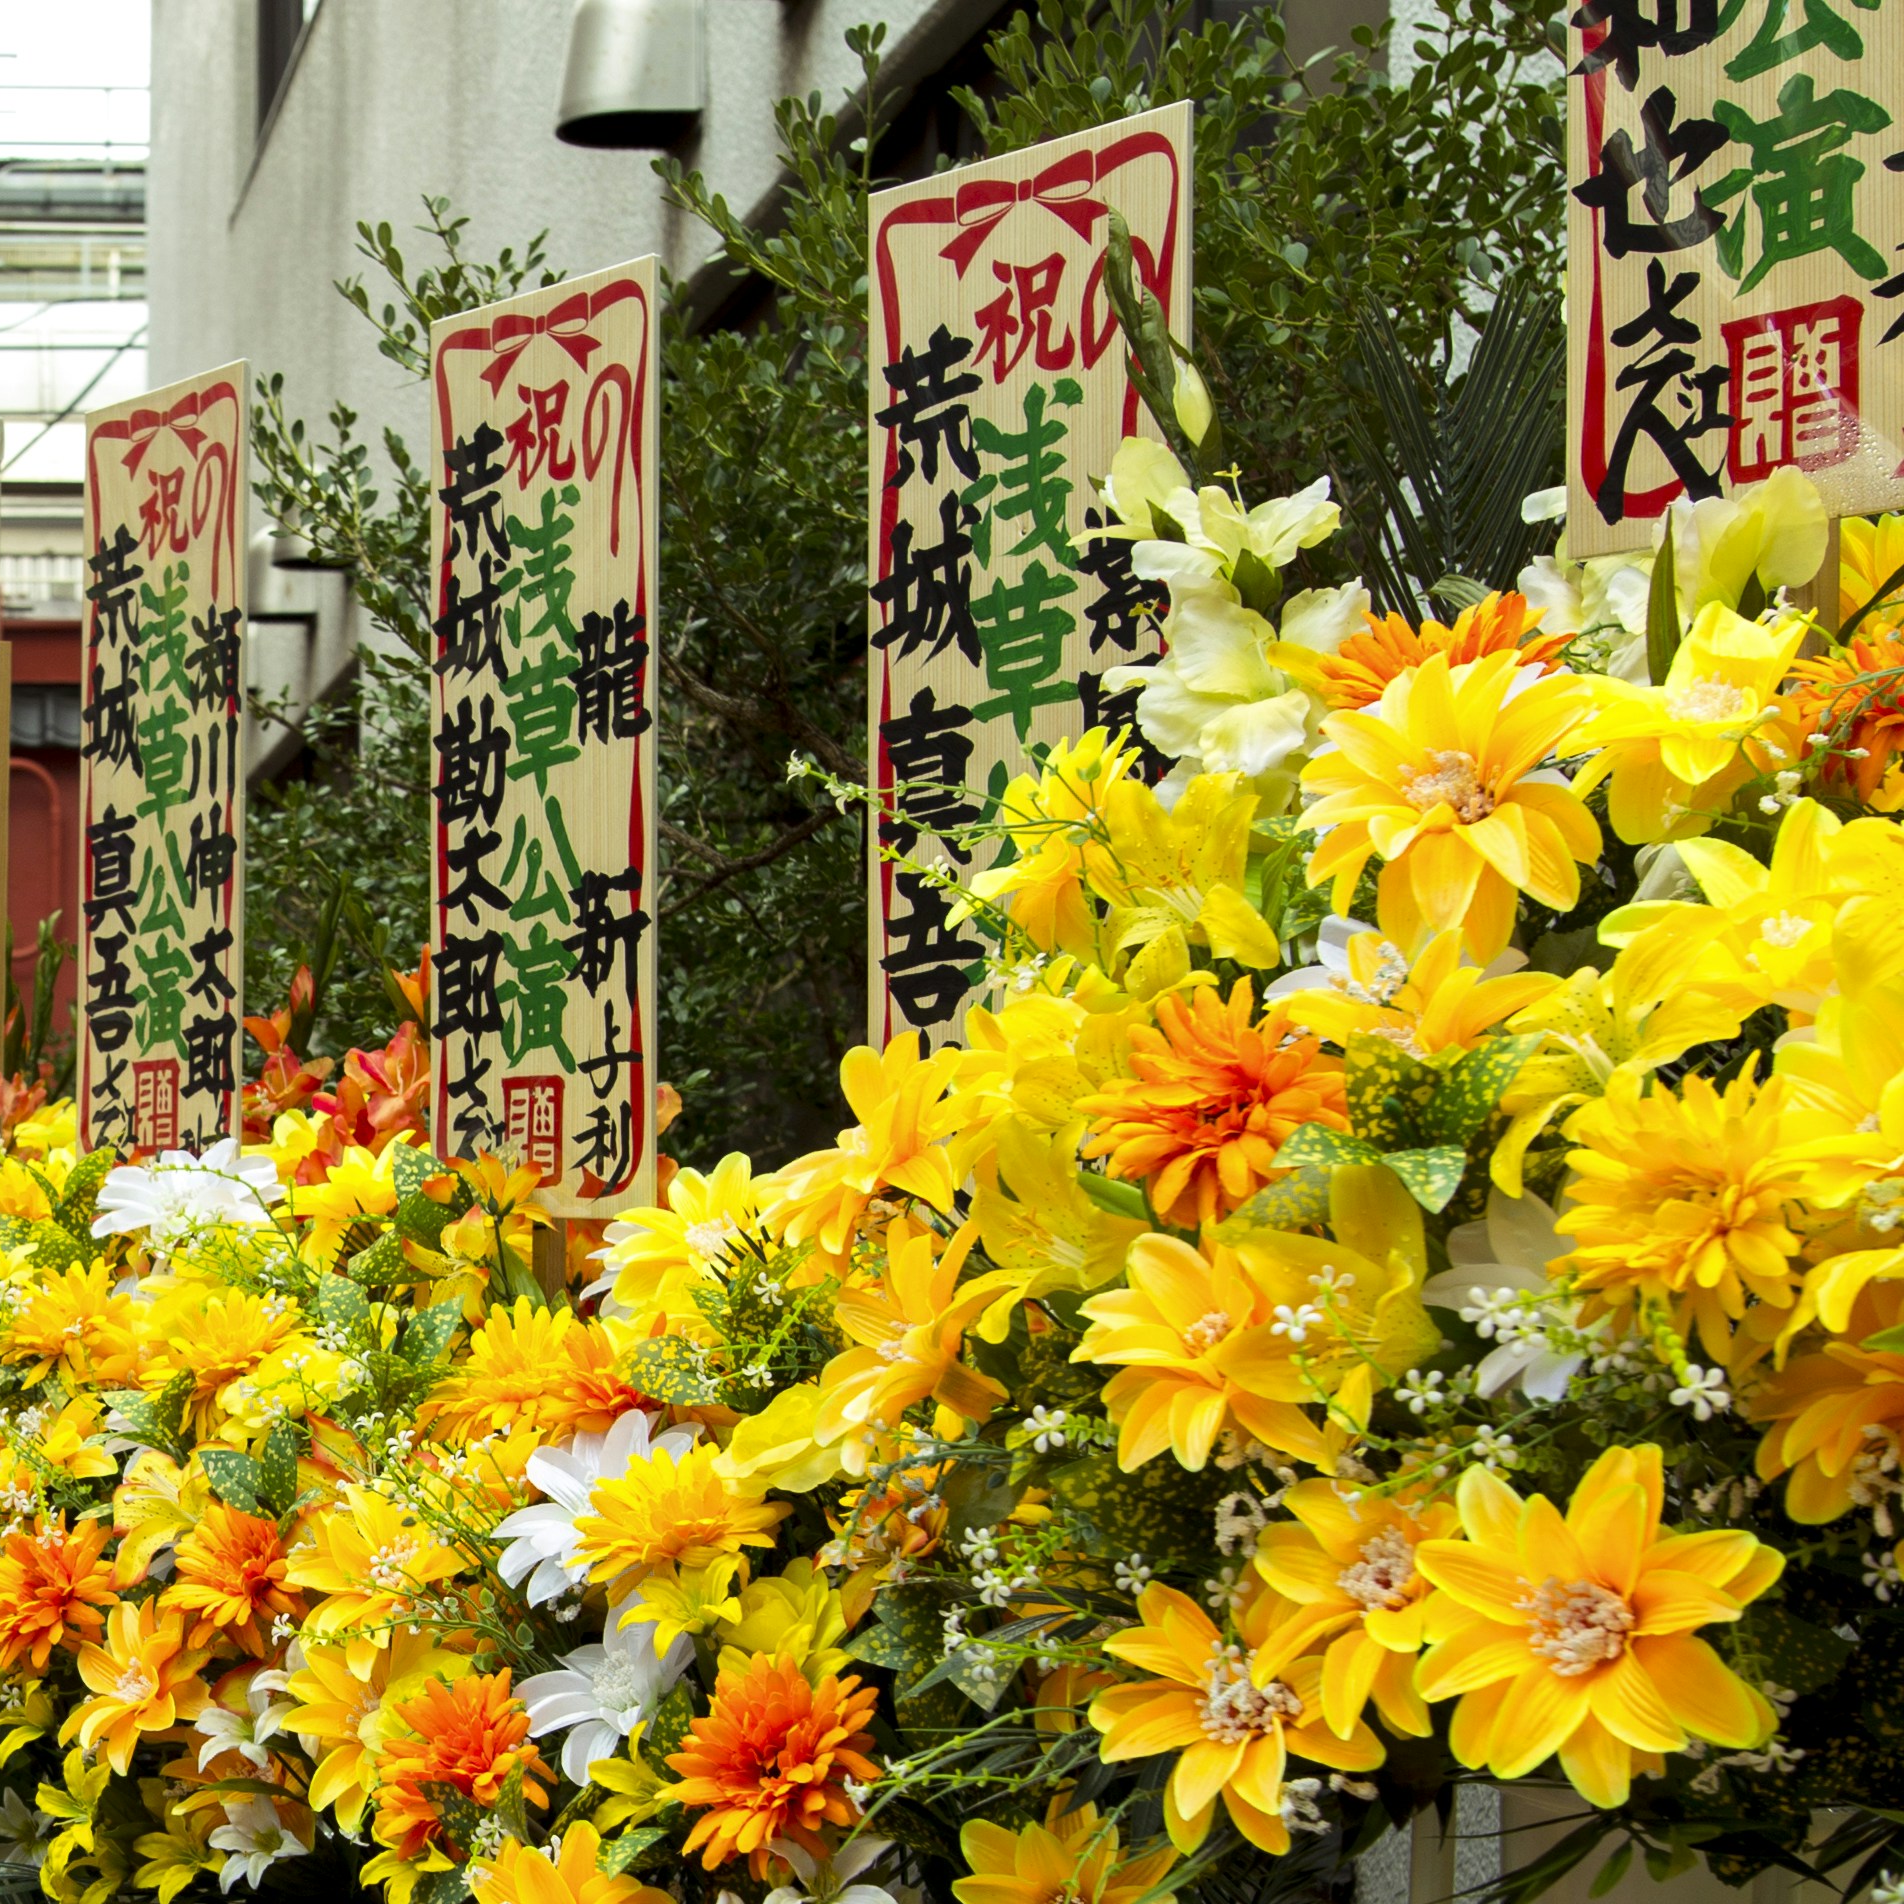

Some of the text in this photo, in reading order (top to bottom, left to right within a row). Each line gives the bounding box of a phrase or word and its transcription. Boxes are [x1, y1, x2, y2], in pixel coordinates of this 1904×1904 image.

[506, 378, 578, 491] 祝
[974, 250, 1076, 384] 祝
[138, 465, 190, 555] 祝
[135, 562, 195, 1061] 浅草公演
[498, 485, 585, 1074] 浅草公演
[870, 322, 986, 1060] 荒城真吾
